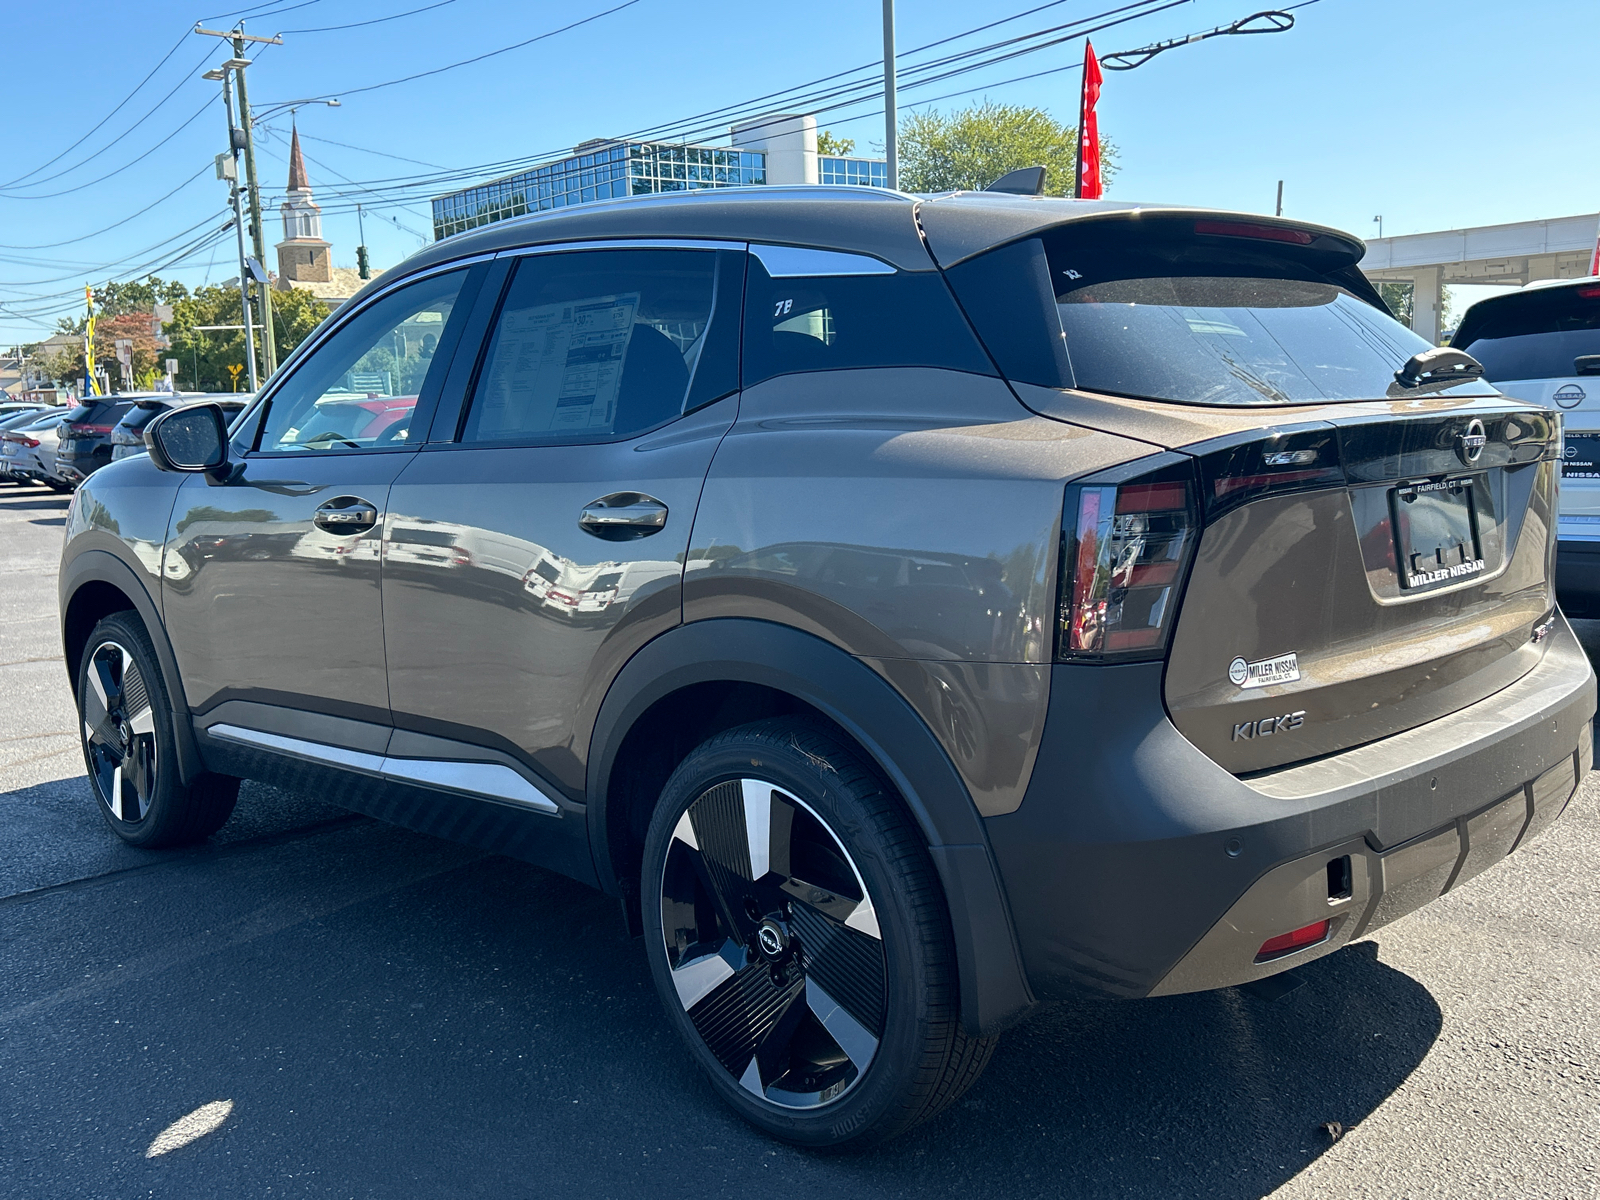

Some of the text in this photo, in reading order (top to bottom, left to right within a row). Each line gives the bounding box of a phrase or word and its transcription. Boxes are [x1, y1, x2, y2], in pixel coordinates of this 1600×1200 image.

[774, 298, 793, 317] 7B
[1448, 480, 1457, 488] CT
[1409, 559, 1485, 588] MILLER NISSAN
[1249, 659, 1298, 679] MILLER NISSAN
[1232, 710, 1306, 742] KICKS
